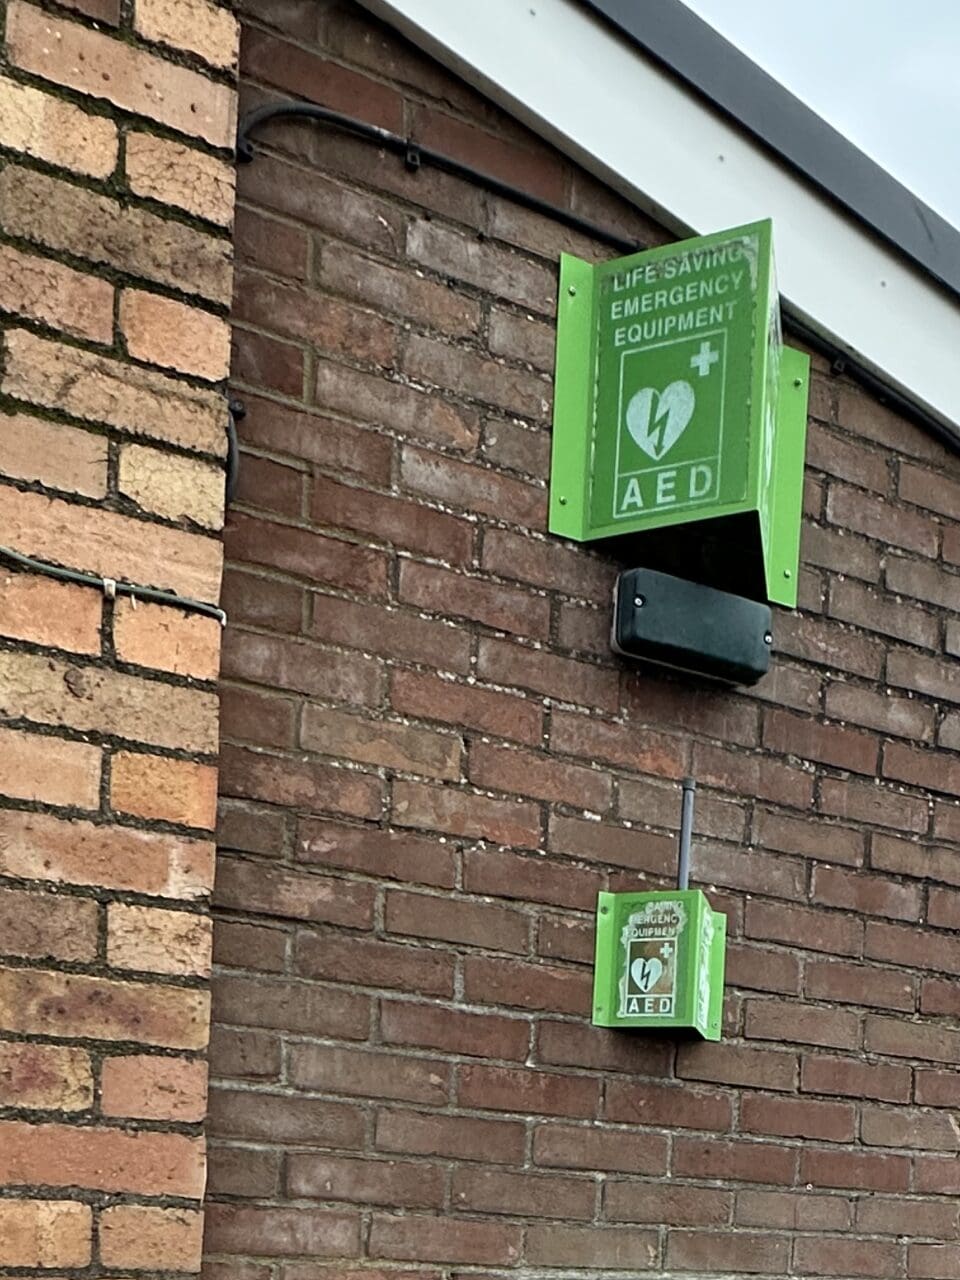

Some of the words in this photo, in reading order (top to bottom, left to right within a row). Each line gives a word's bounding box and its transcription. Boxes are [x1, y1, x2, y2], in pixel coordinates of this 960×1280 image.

[613, 265, 657, 292] LIFE
[664, 246, 742, 279] SAVING
[611, 270, 743, 320] EMERGENCY
[614, 300, 737, 347] EQUIPMENT
